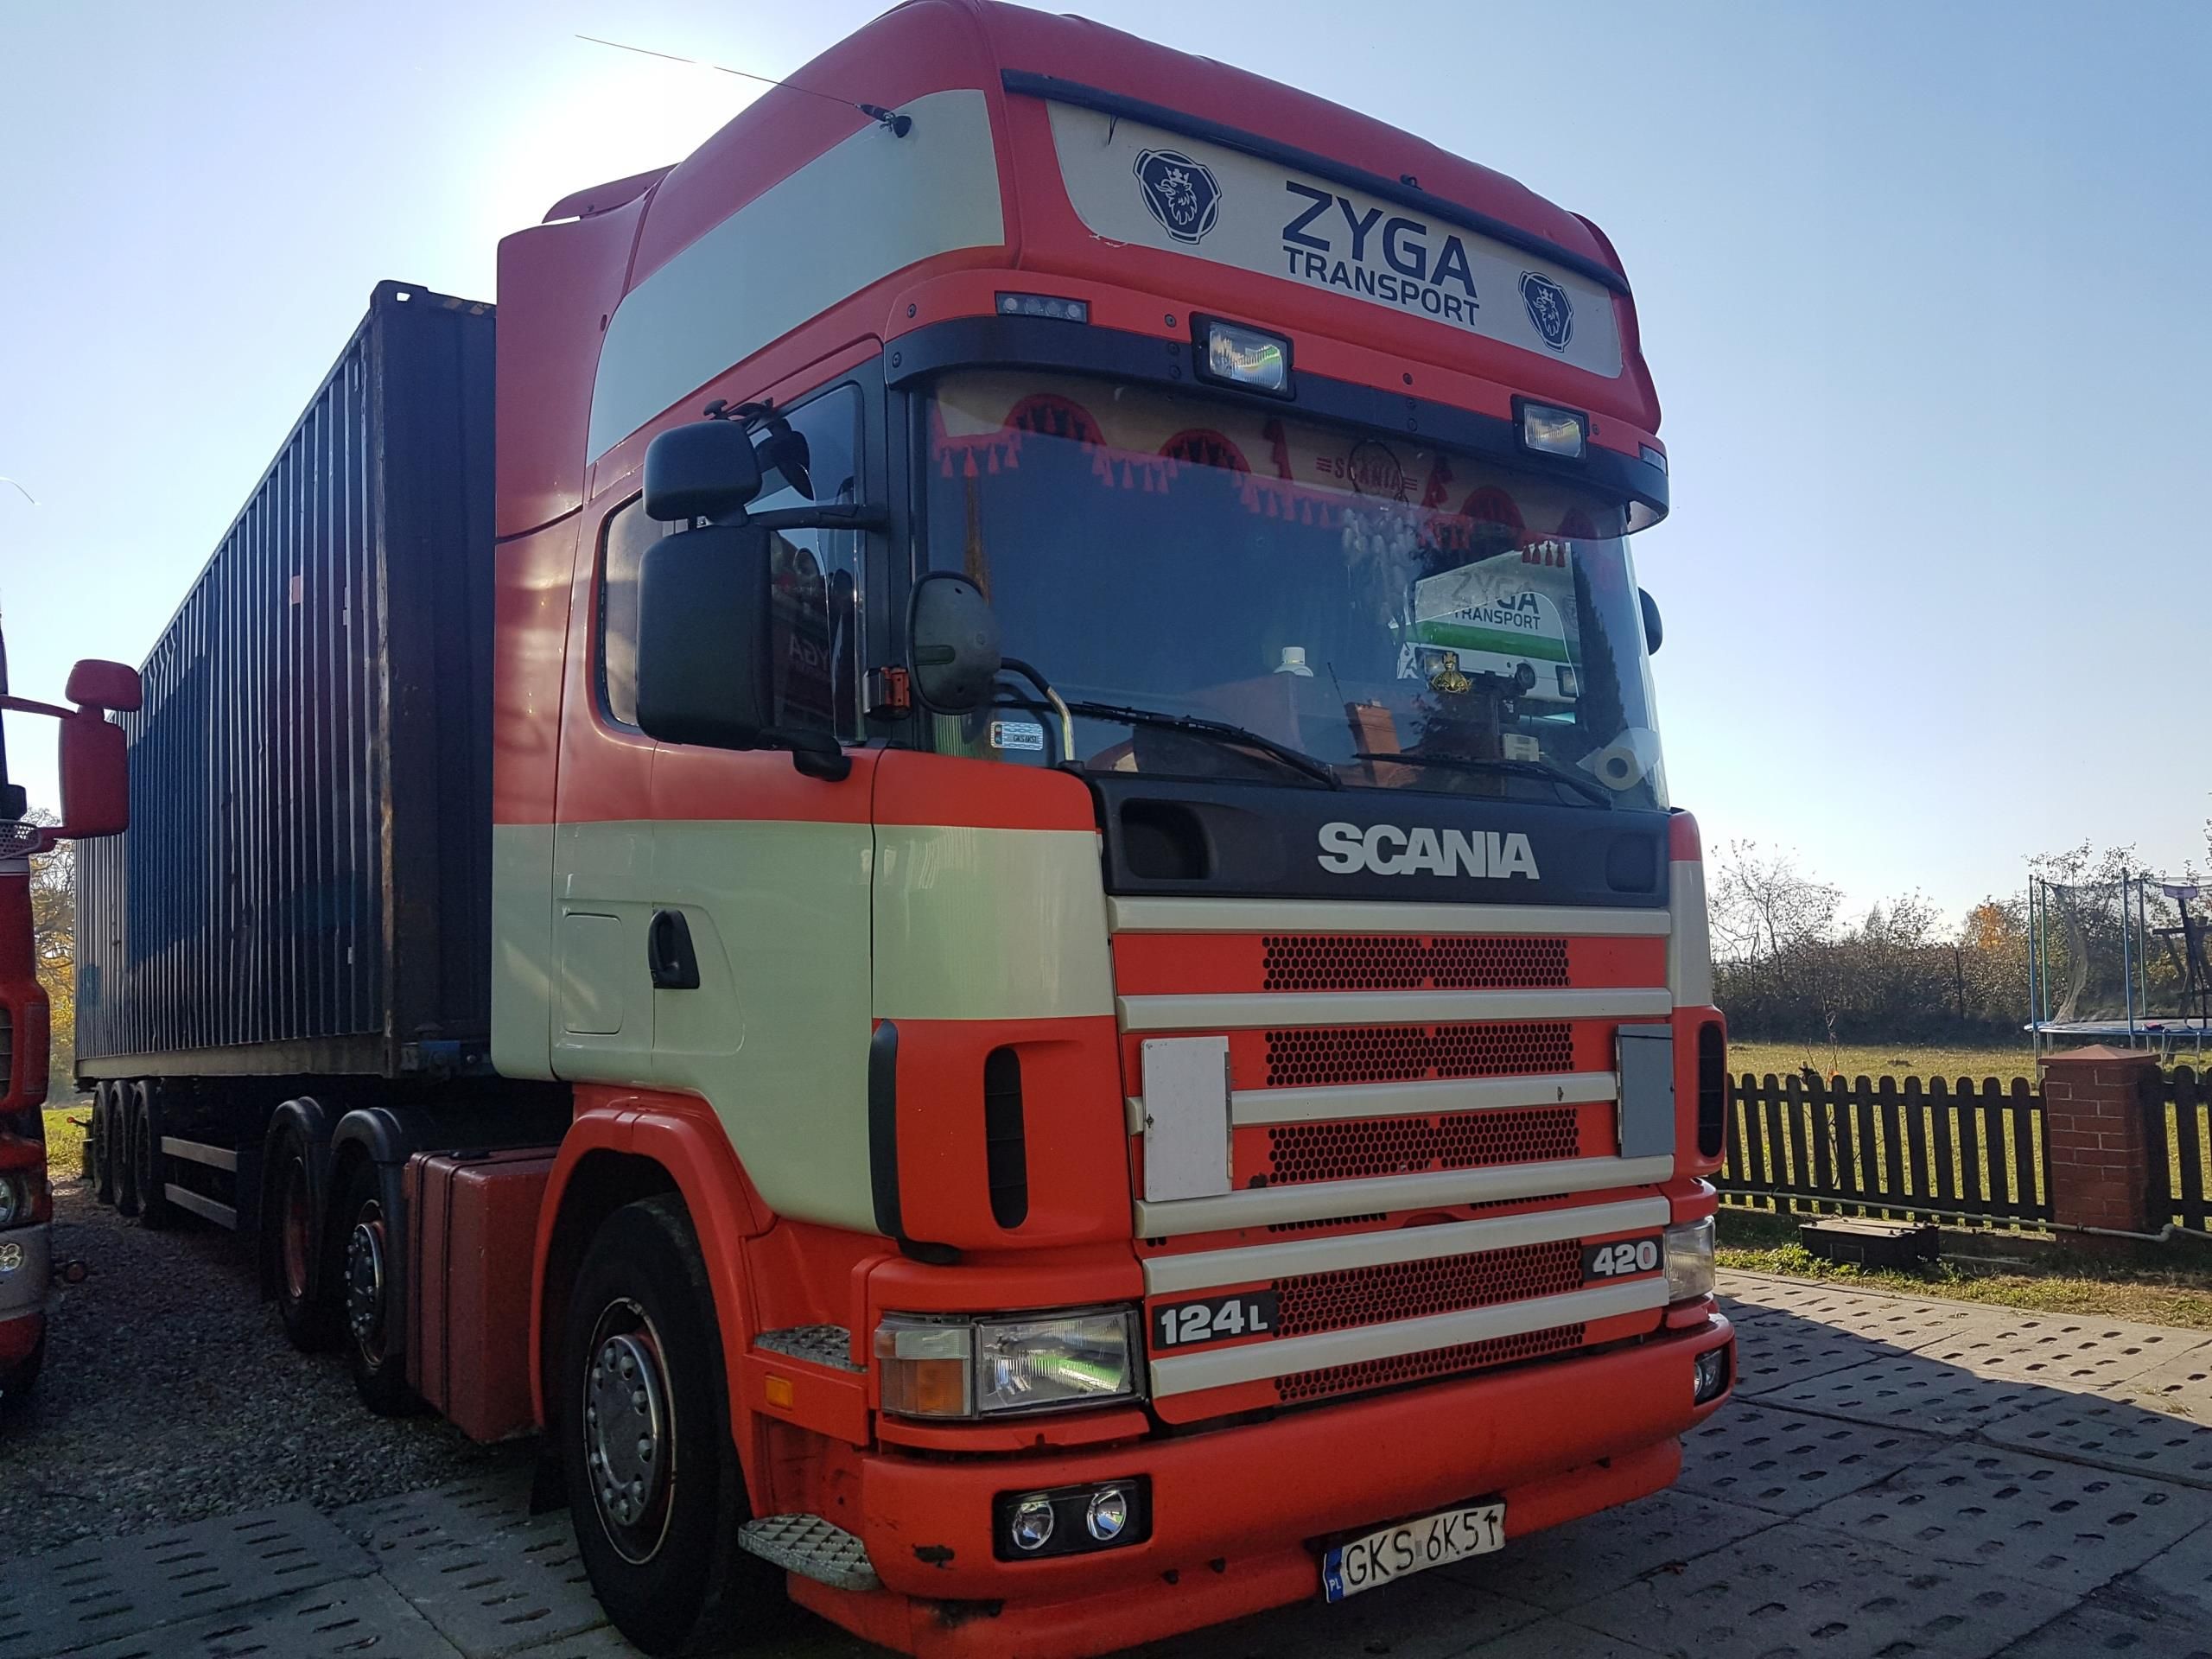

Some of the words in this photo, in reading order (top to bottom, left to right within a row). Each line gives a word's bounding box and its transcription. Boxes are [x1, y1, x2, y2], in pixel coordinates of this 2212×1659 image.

[1282, 180, 1478, 299] ZYGA
[1282, 245, 1480, 326] TRANSPORT
[1335, 457, 1402, 491] SCANIA
[1317, 822, 1541, 880] SCANIA
[1592, 1241, 1658, 1276] 420
[1328, 1580, 1341, 1592] PL
[1345, 1529, 1414, 1586] GKS
